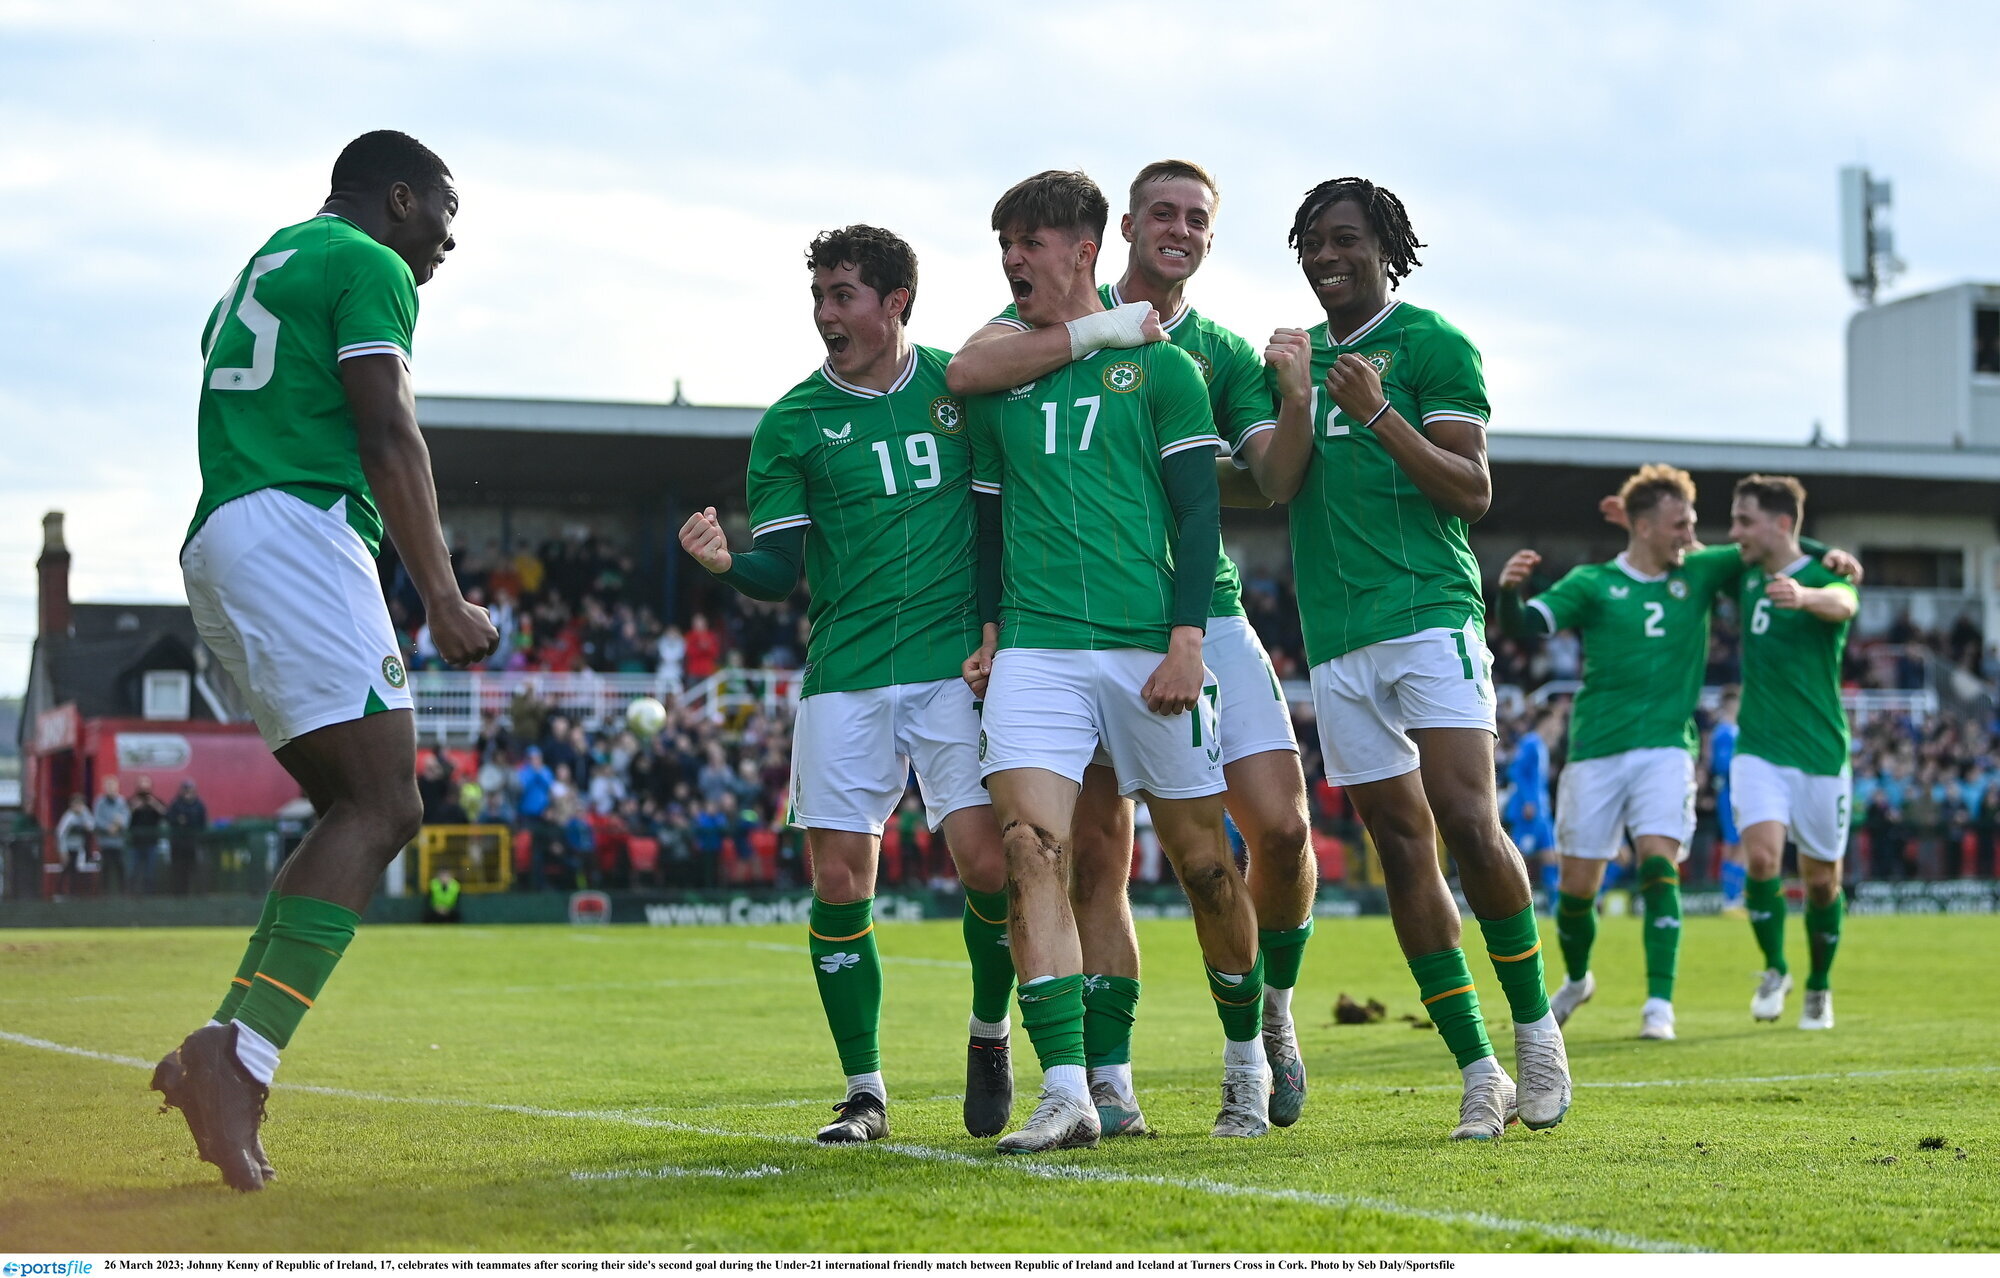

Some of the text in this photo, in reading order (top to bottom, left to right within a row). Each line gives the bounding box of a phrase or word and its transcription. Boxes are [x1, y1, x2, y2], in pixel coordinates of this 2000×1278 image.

[1040, 395, 1101, 455] 17
[871, 432, 942, 496] 19
[1643, 602, 1666, 637] 2
[1750, 600, 1771, 635] 6
